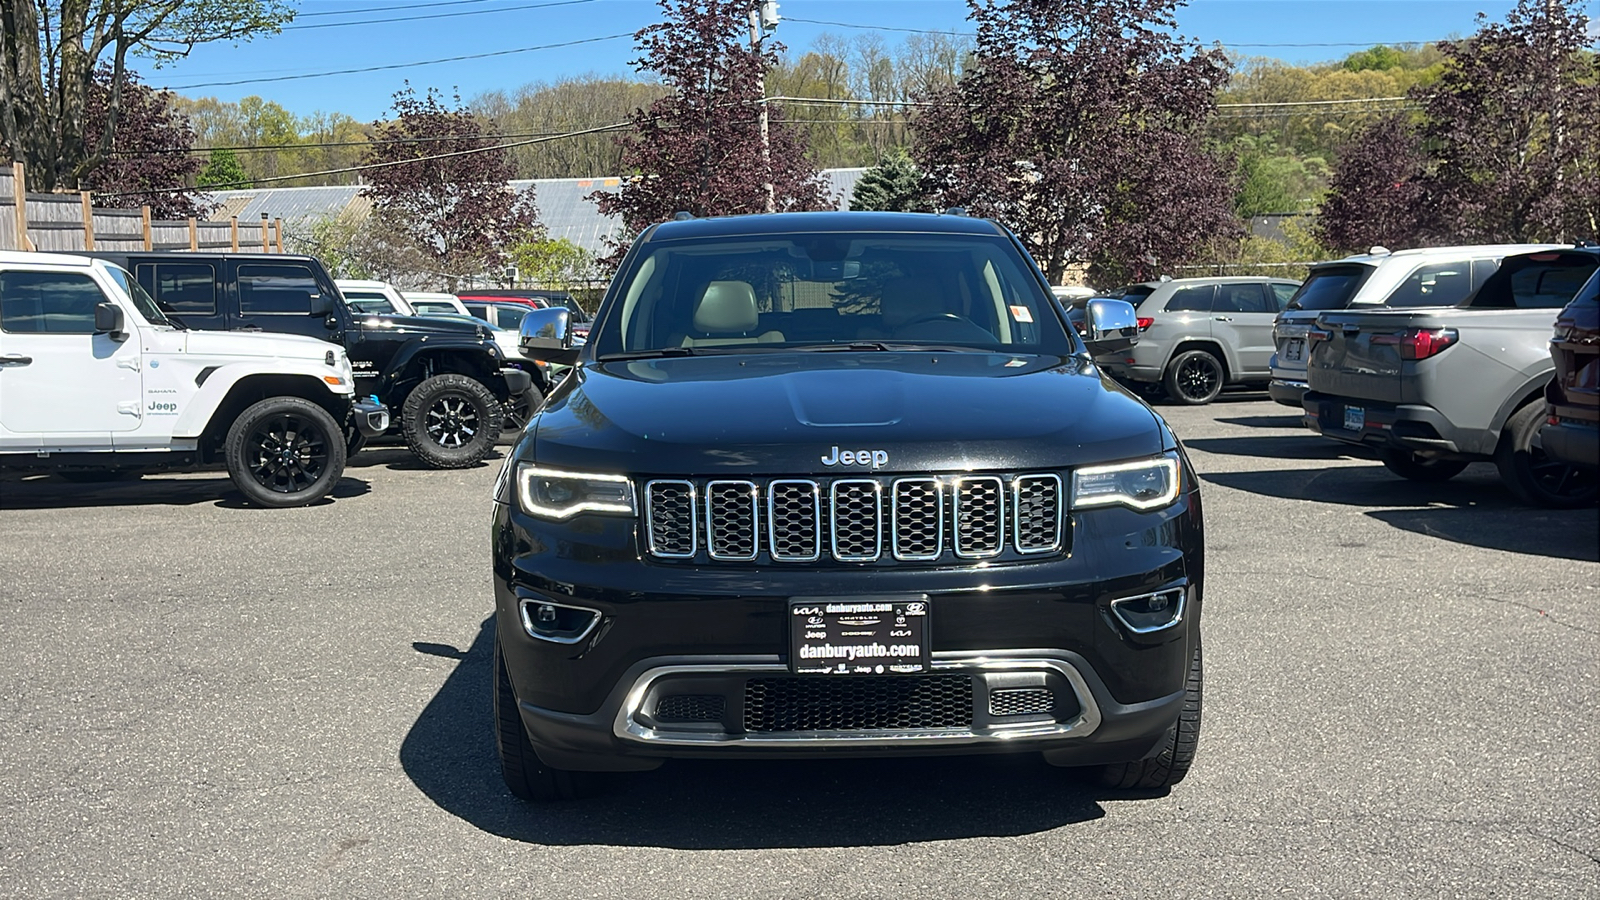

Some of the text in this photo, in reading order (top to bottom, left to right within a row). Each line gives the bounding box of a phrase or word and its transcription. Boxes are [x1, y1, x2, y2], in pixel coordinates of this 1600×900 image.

[147, 400, 177, 412] Jeep
[821, 446, 889, 469] Jeep
[826, 603, 893, 614] danburyauto.com
[805, 631, 827, 639] Jeep
[800, 642, 920, 660] danburyauto.com
[853, 665, 872, 674] Jeep
